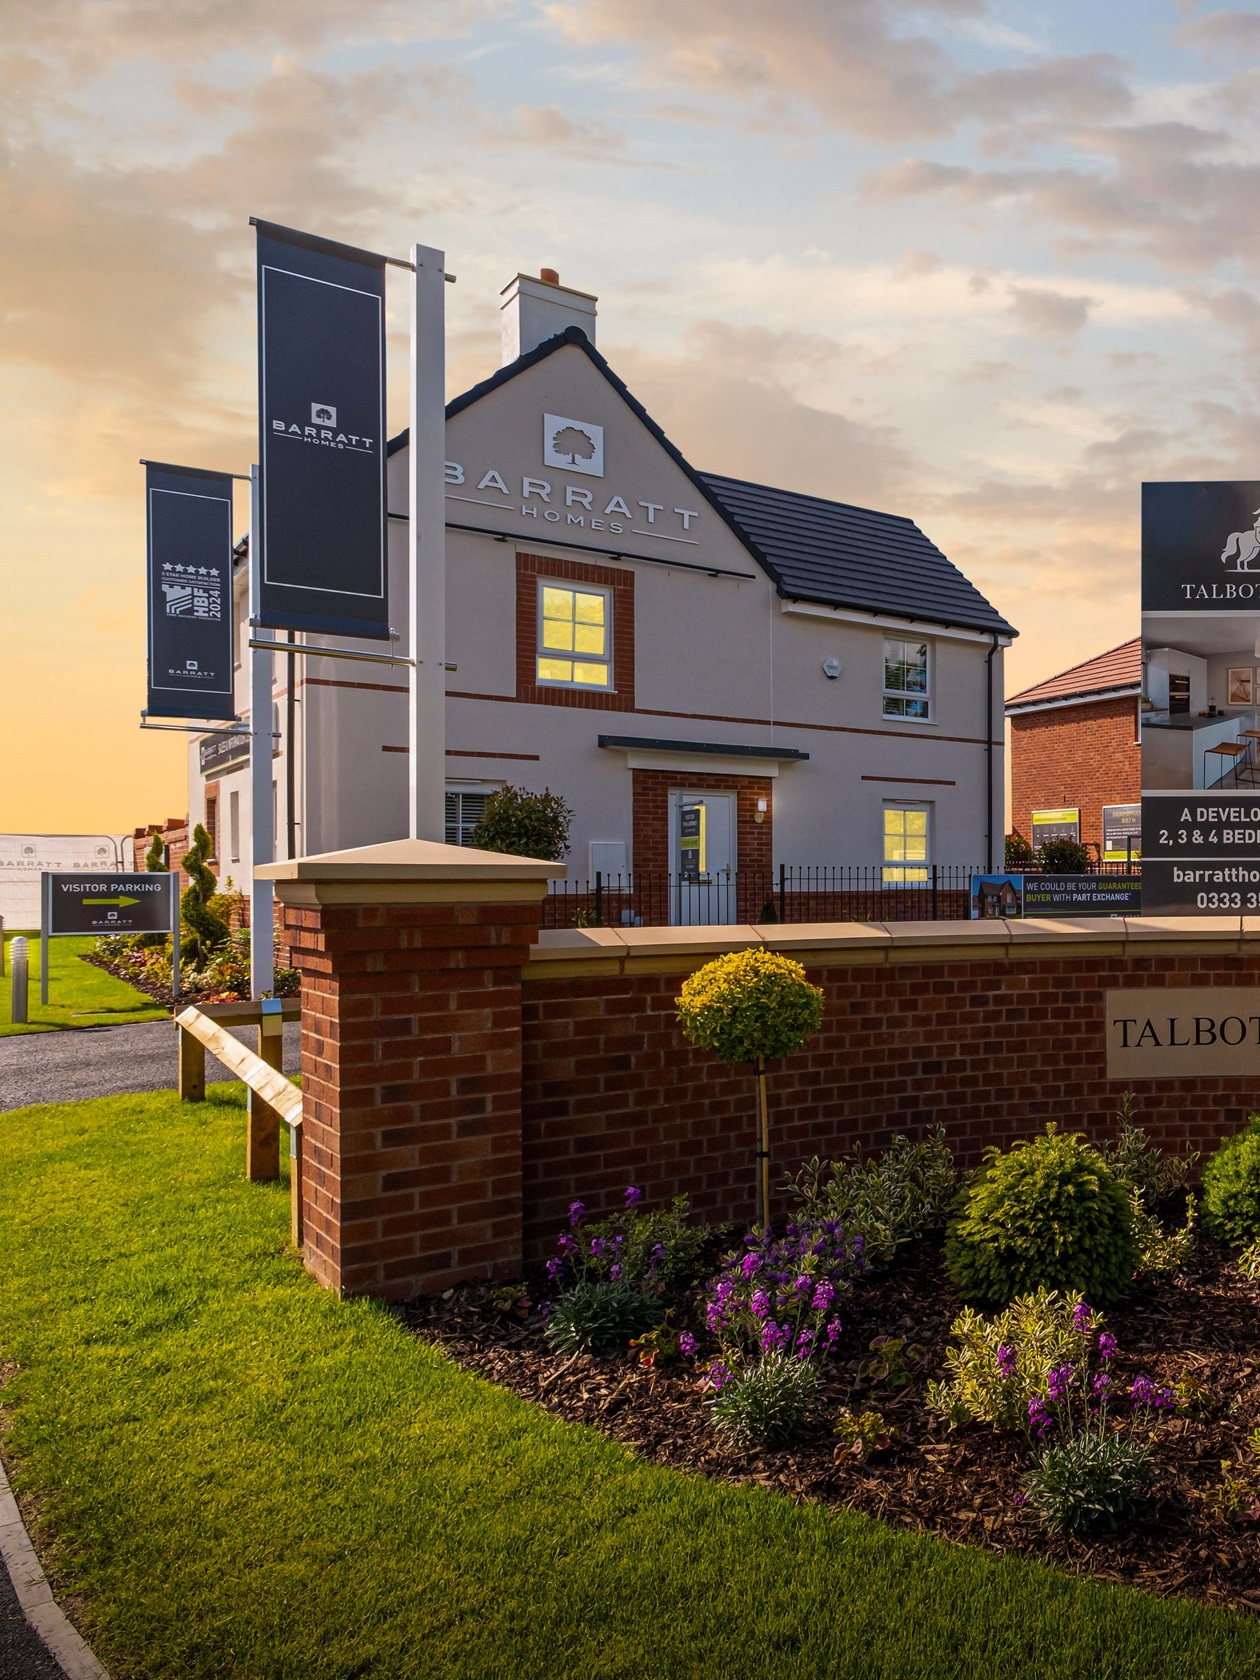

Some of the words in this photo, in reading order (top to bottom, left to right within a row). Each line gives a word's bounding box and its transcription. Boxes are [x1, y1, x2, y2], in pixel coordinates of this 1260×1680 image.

[272, 420, 373, 447] BARRATT
[304, 437, 344, 449] HOMES
[445, 461, 698, 530] BARRATT
[521, 504, 624, 534] HOMES
[194, 588, 208, 617] HBF
[210, 590, 221, 618] 2024
[1180, 808, 1192, 821] A
[1159, 830, 1173, 846] 2,
[1178, 830, 1188, 843] 3
[1192, 830, 1204, 843] &
[1208, 830, 1218, 843] 4
[62, 884, 107, 892] VISITOR
[111, 884, 162, 892] PARKING
[1027, 882, 1038, 890] WE
[1040, 882, 1065, 890] COULD
[1077, 882, 1096, 890] YOUR
[1196, 893, 1241, 909] 0333
